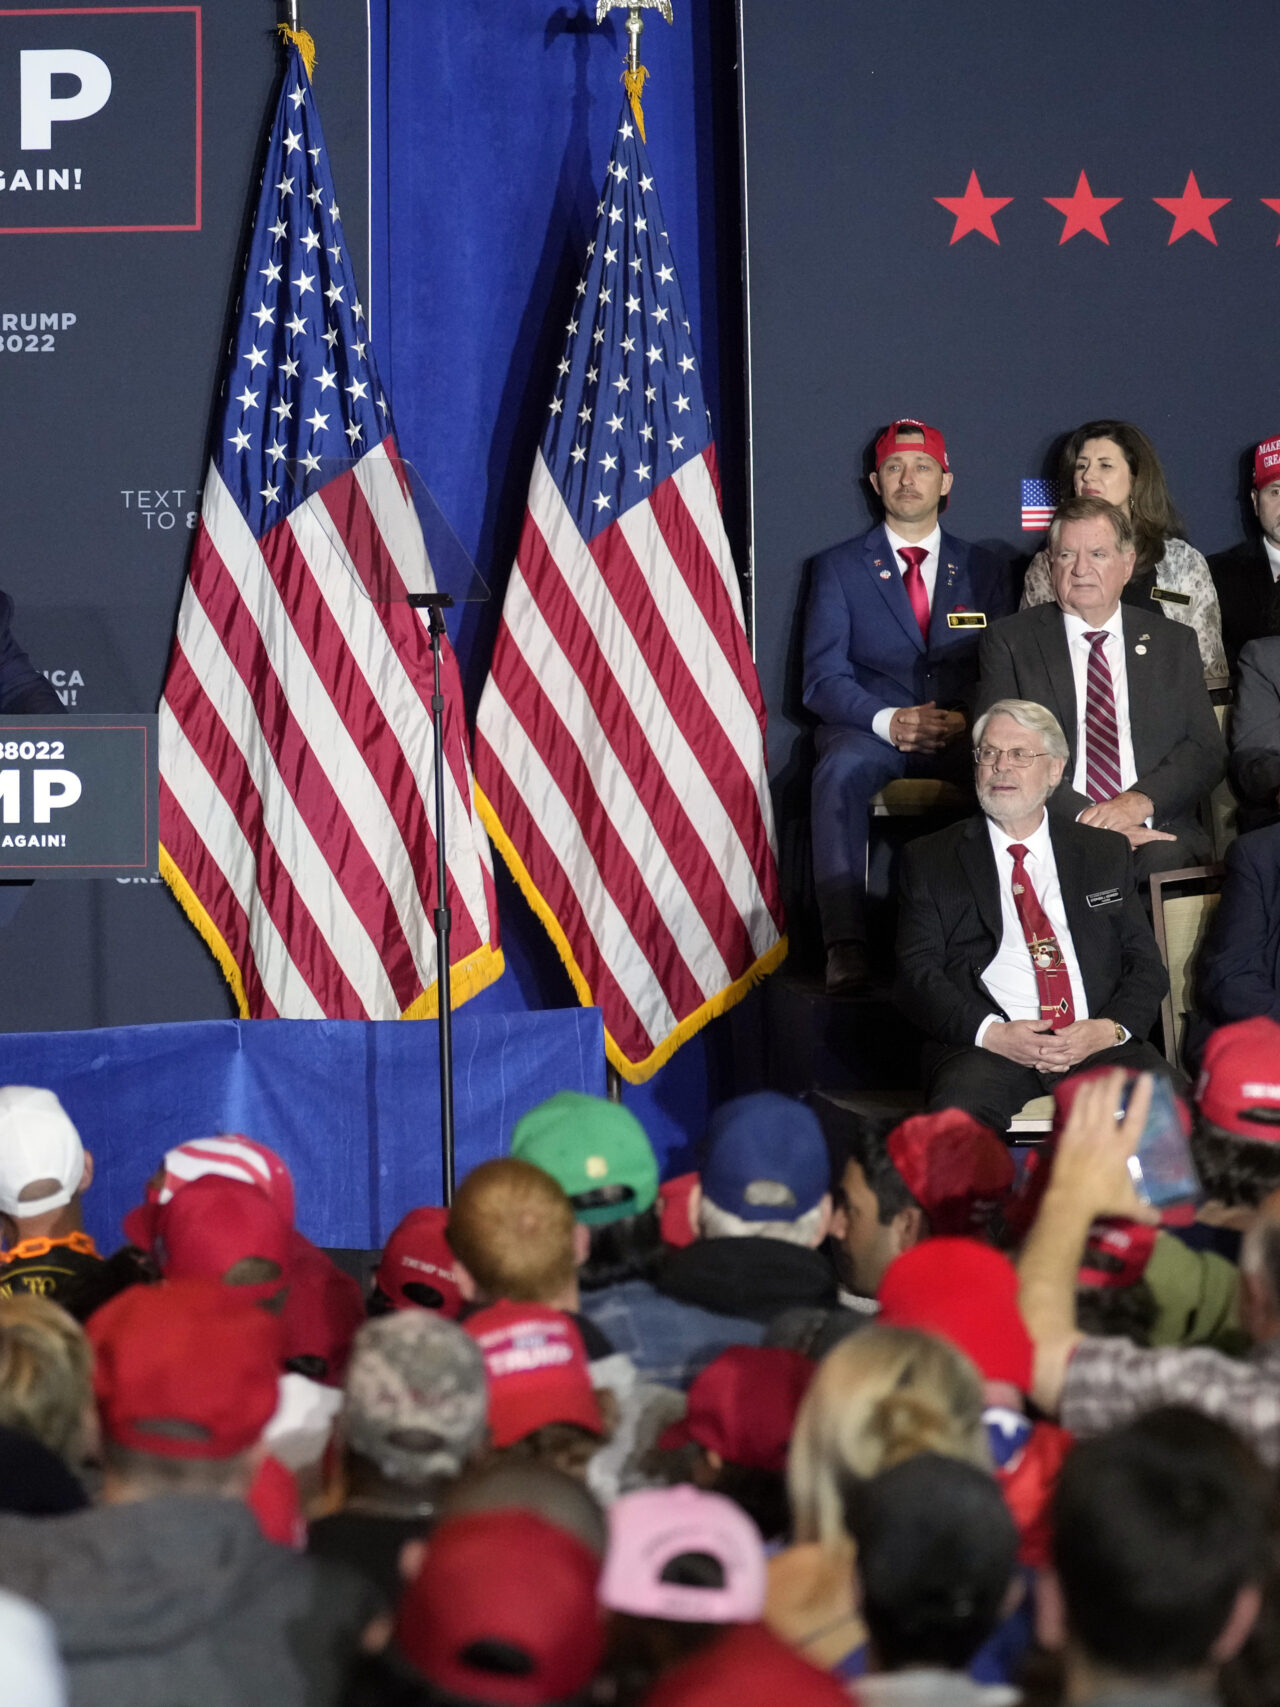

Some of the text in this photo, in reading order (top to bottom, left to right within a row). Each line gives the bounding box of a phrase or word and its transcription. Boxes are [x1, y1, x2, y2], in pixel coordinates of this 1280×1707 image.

[121, 490, 185, 508] TEXT
[143, 512, 175, 529] TO
[2, 835, 65, 847] AGAIN!
